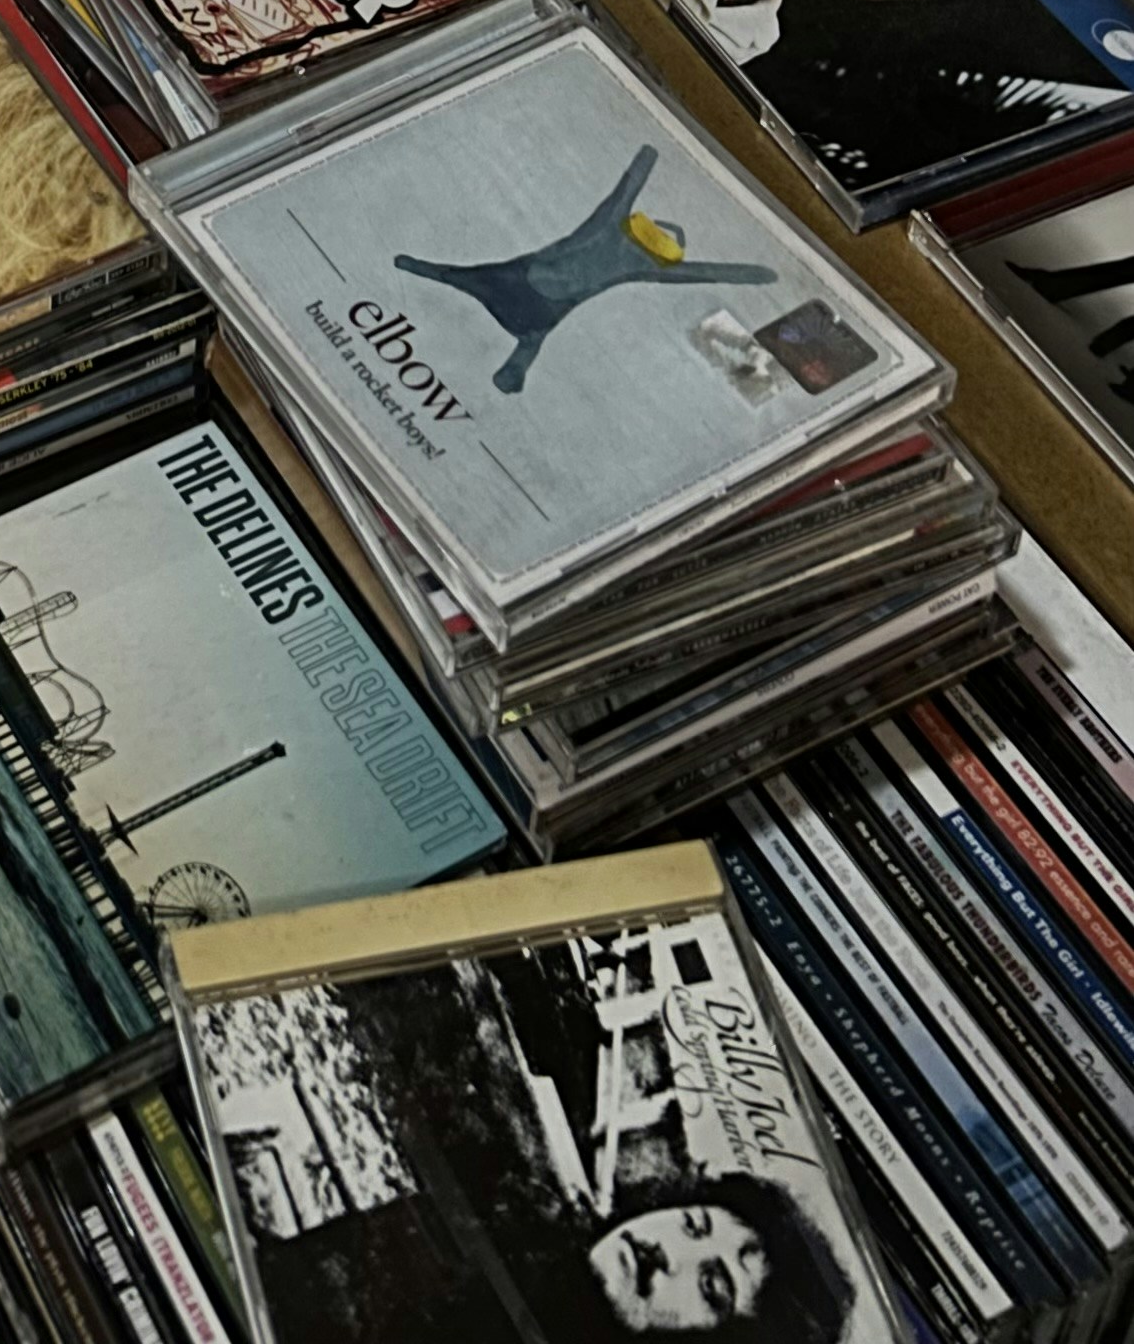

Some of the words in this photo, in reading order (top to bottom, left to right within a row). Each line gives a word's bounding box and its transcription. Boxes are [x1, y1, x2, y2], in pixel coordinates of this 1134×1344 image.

[305, 299, 353, 349] build
[340, 348, 356, 363] a
[352, 361, 403, 416] rocket
[396, 411, 447, 461] boys!
[348, 300, 474, 421] elbow
[156, 434, 241, 505] THE
[192, 487, 325, 625] DELINES
[278, 606, 369, 689] THE
[319, 668, 412, 757] SEA
[365, 733, 488, 855] DRIFT
[888, 808, 916, 838] THE
[908, 834, 966, 902] FABULOUS
[958, 900, 1043, 1005] THUNDERBIRDS
[1036, 1001, 1077, 1047] Tacos
[704, 986, 787, 1093] Billy
[723, 853, 784, 930] 26775-2
[783, 939, 825, 989] Enya
[830, 1005, 907, 1101] Shepherd
[901, 1102, 955, 1169] Moons
[962, 1187, 1030, 1272] Reprise
[726, 1082, 825, 1171] Joel
[121, 1171, 161, 1234] FUGEES
